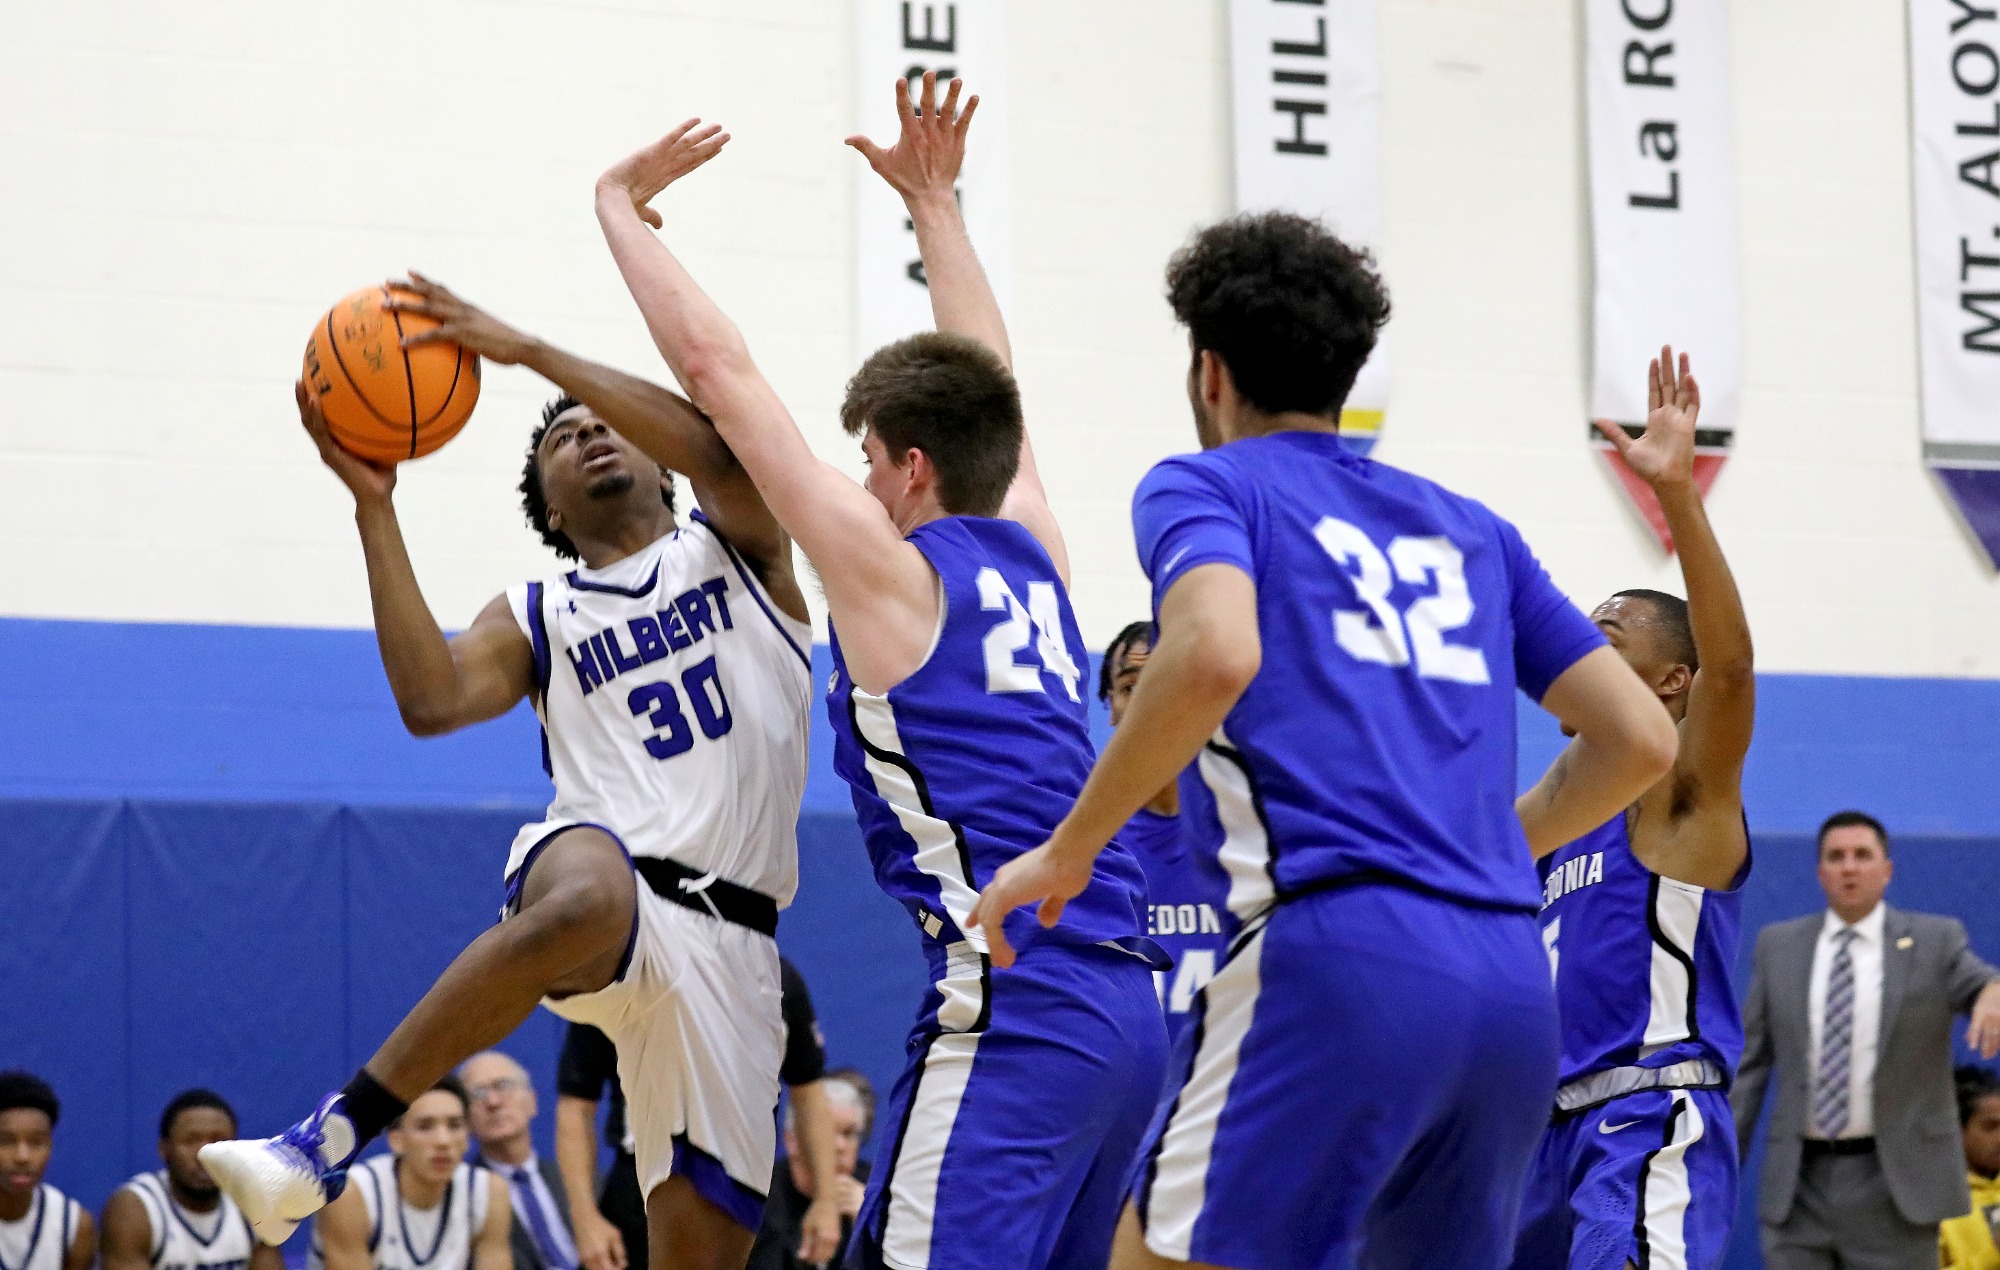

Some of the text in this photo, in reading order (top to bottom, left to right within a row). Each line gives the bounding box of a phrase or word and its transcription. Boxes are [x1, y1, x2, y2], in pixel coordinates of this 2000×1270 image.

[1271, 0, 1328, 156] HIL
[1628, 118, 1682, 210] La
[1949, 0, 2000, 355] MT. ALOY
[566, 577, 734, 697] HILBERT
[974, 566, 1082, 704] 24
[1312, 515, 1491, 685] 32
[627, 655, 733, 761] 30
